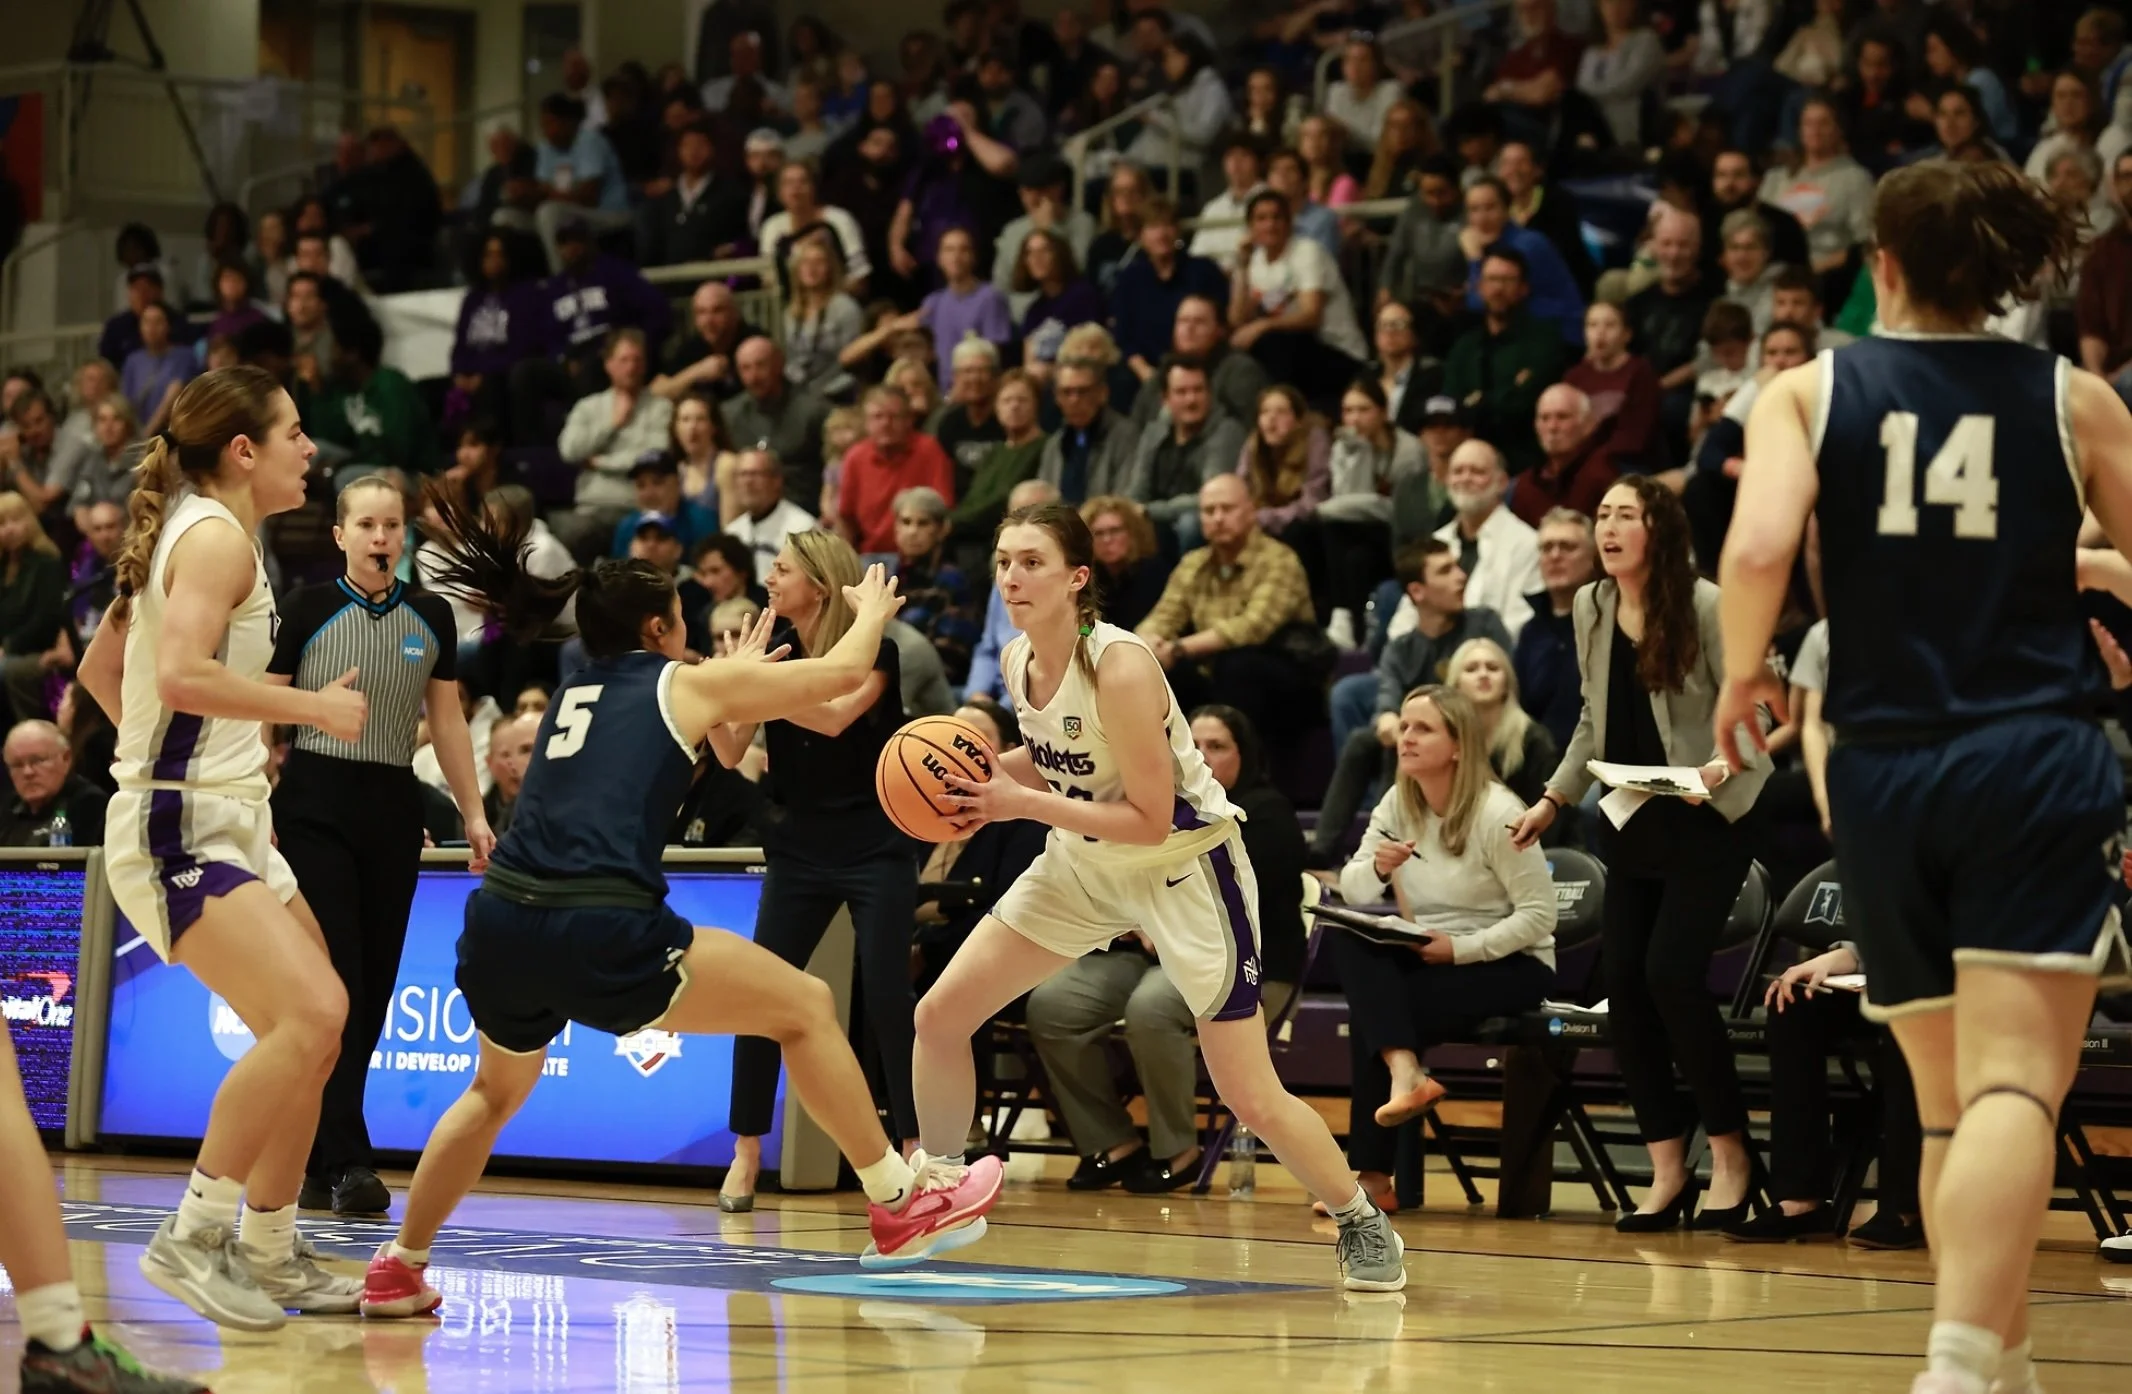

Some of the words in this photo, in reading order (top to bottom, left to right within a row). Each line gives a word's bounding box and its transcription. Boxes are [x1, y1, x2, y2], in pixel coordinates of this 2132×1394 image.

[1877, 411, 1999, 538] 14
[545, 684, 604, 760] 5
[1067, 721, 1080, 732] 50
[395, 1051, 472, 1073] DEVELOP
